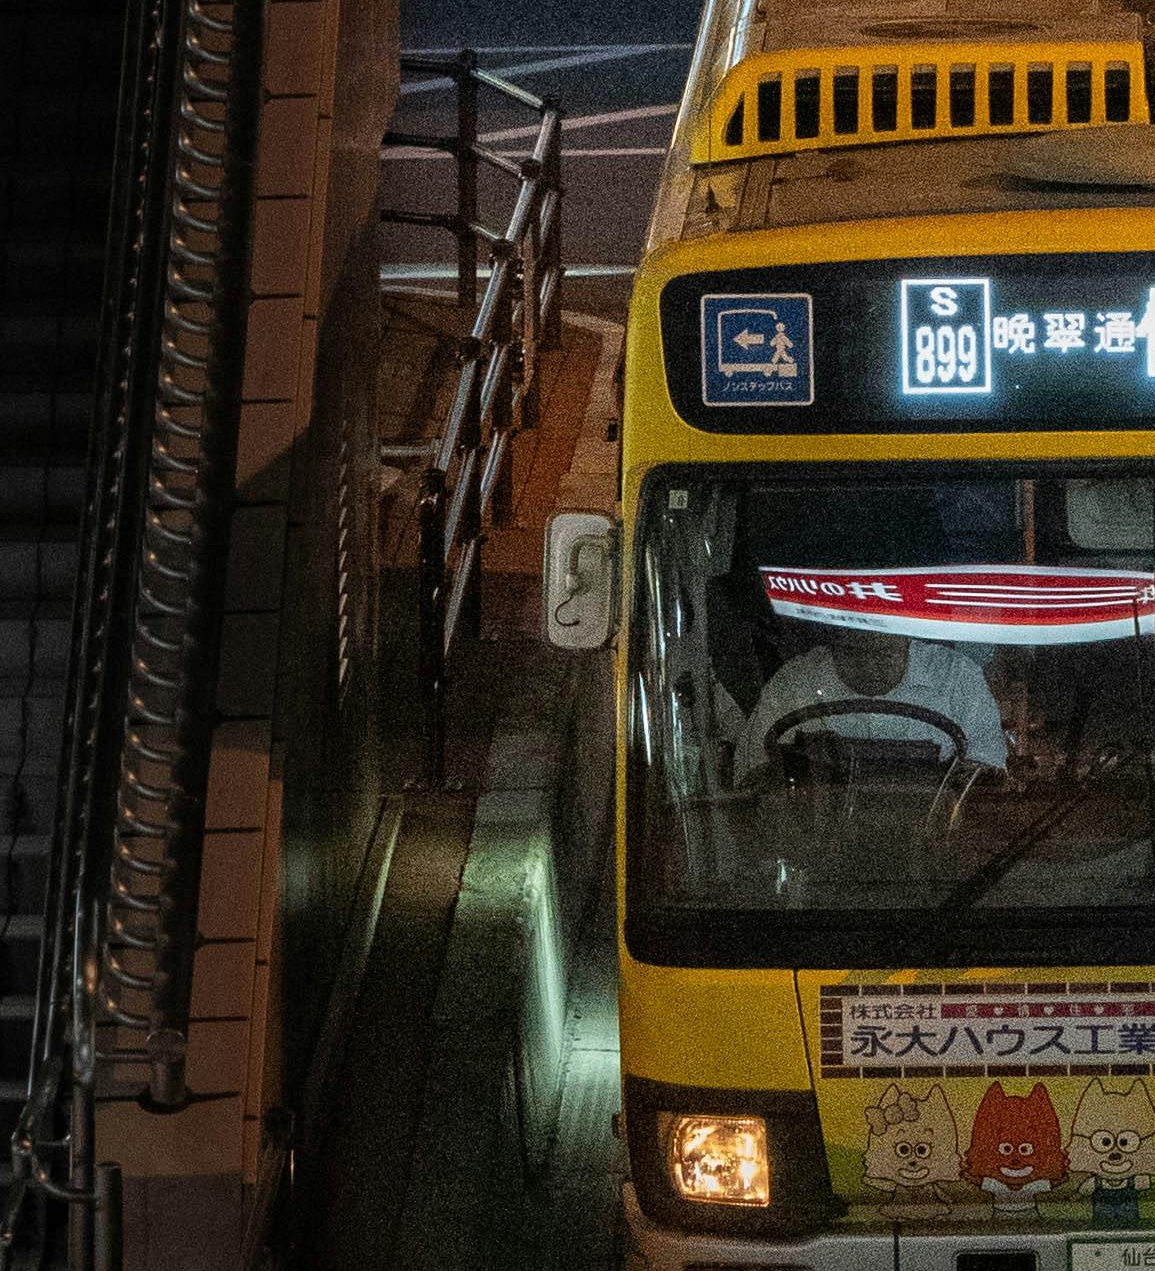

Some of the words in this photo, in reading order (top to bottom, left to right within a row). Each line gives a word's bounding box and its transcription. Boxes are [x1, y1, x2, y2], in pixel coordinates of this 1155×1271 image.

[929, 286, 959, 316] S
[992, 312, 1137, 355] 晩翠通
[915, 325, 978, 384] 899
[850, 1003, 938, 1020] 株式会社
